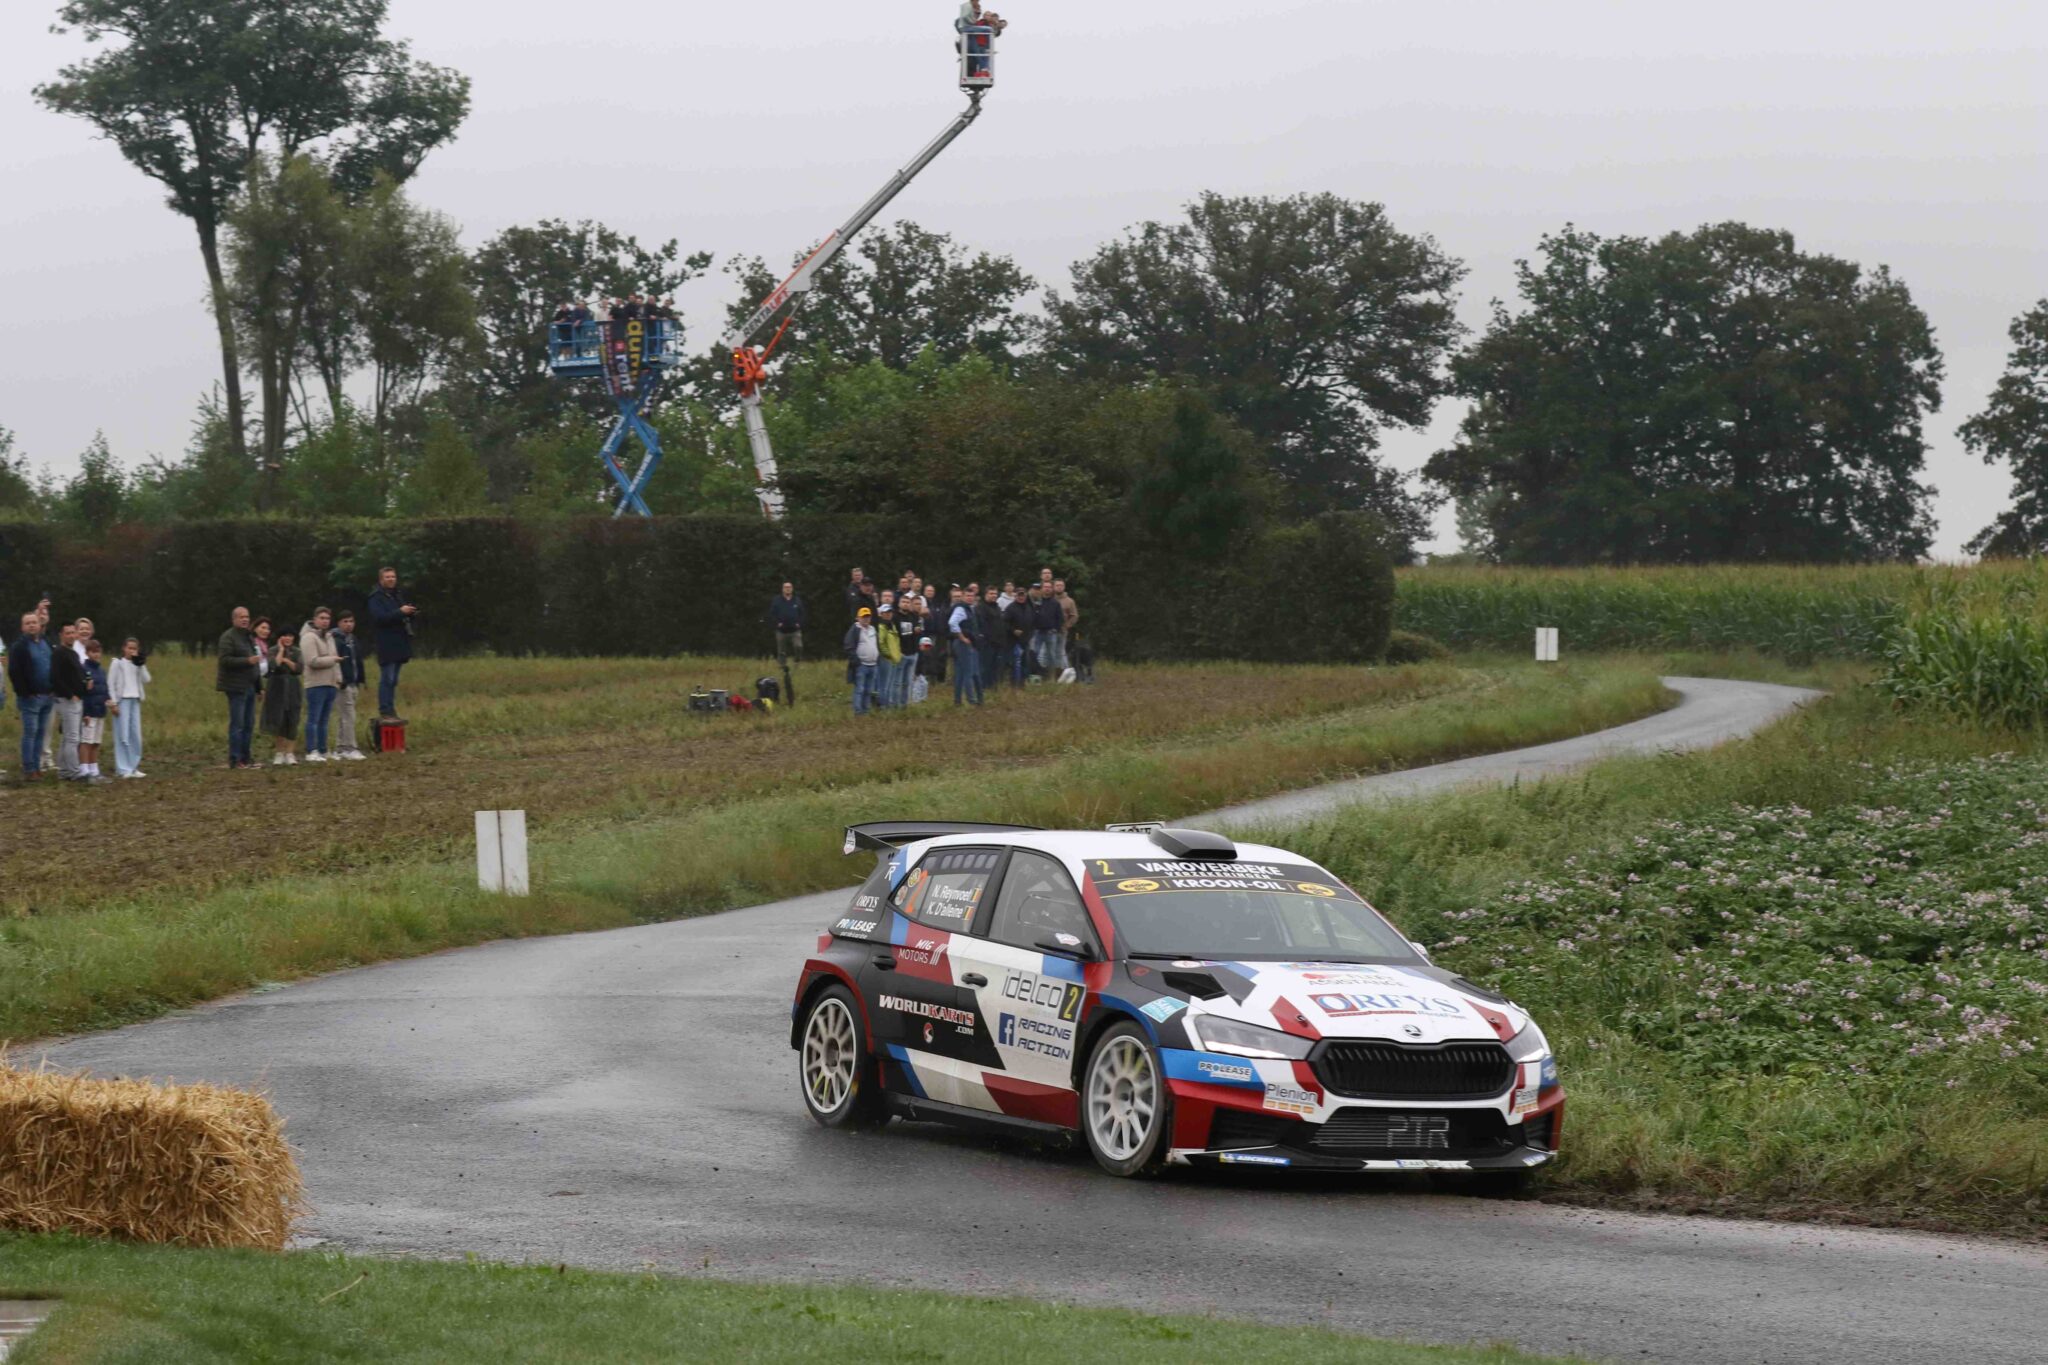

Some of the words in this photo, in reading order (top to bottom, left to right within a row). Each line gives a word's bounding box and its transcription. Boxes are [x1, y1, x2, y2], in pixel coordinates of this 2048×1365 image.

[1096, 861, 1115, 875] 2
[1136, 861, 1284, 876] VANOVERBEKE
[1164, 871, 1271, 880] VERZEKERINGEN
[1172, 879, 1287, 891] KROON-OIL
[916, 939, 935, 950] MIG
[898, 948, 930, 964] MOTORS
[1001, 968, 1062, 1008] idelco
[1063, 986, 1079, 1019] 2
[879, 994, 975, 1026] WORLDKARTS
[955, 1026, 974, 1035] .COM
[1018, 1018, 1072, 1040] RACING
[1017, 1037, 1070, 1059] ACTION
[1199, 1062, 1250, 1075] PROLEASE
[1266, 1083, 1317, 1101] Plenion
[1387, 1116, 1449, 1148] PTR
